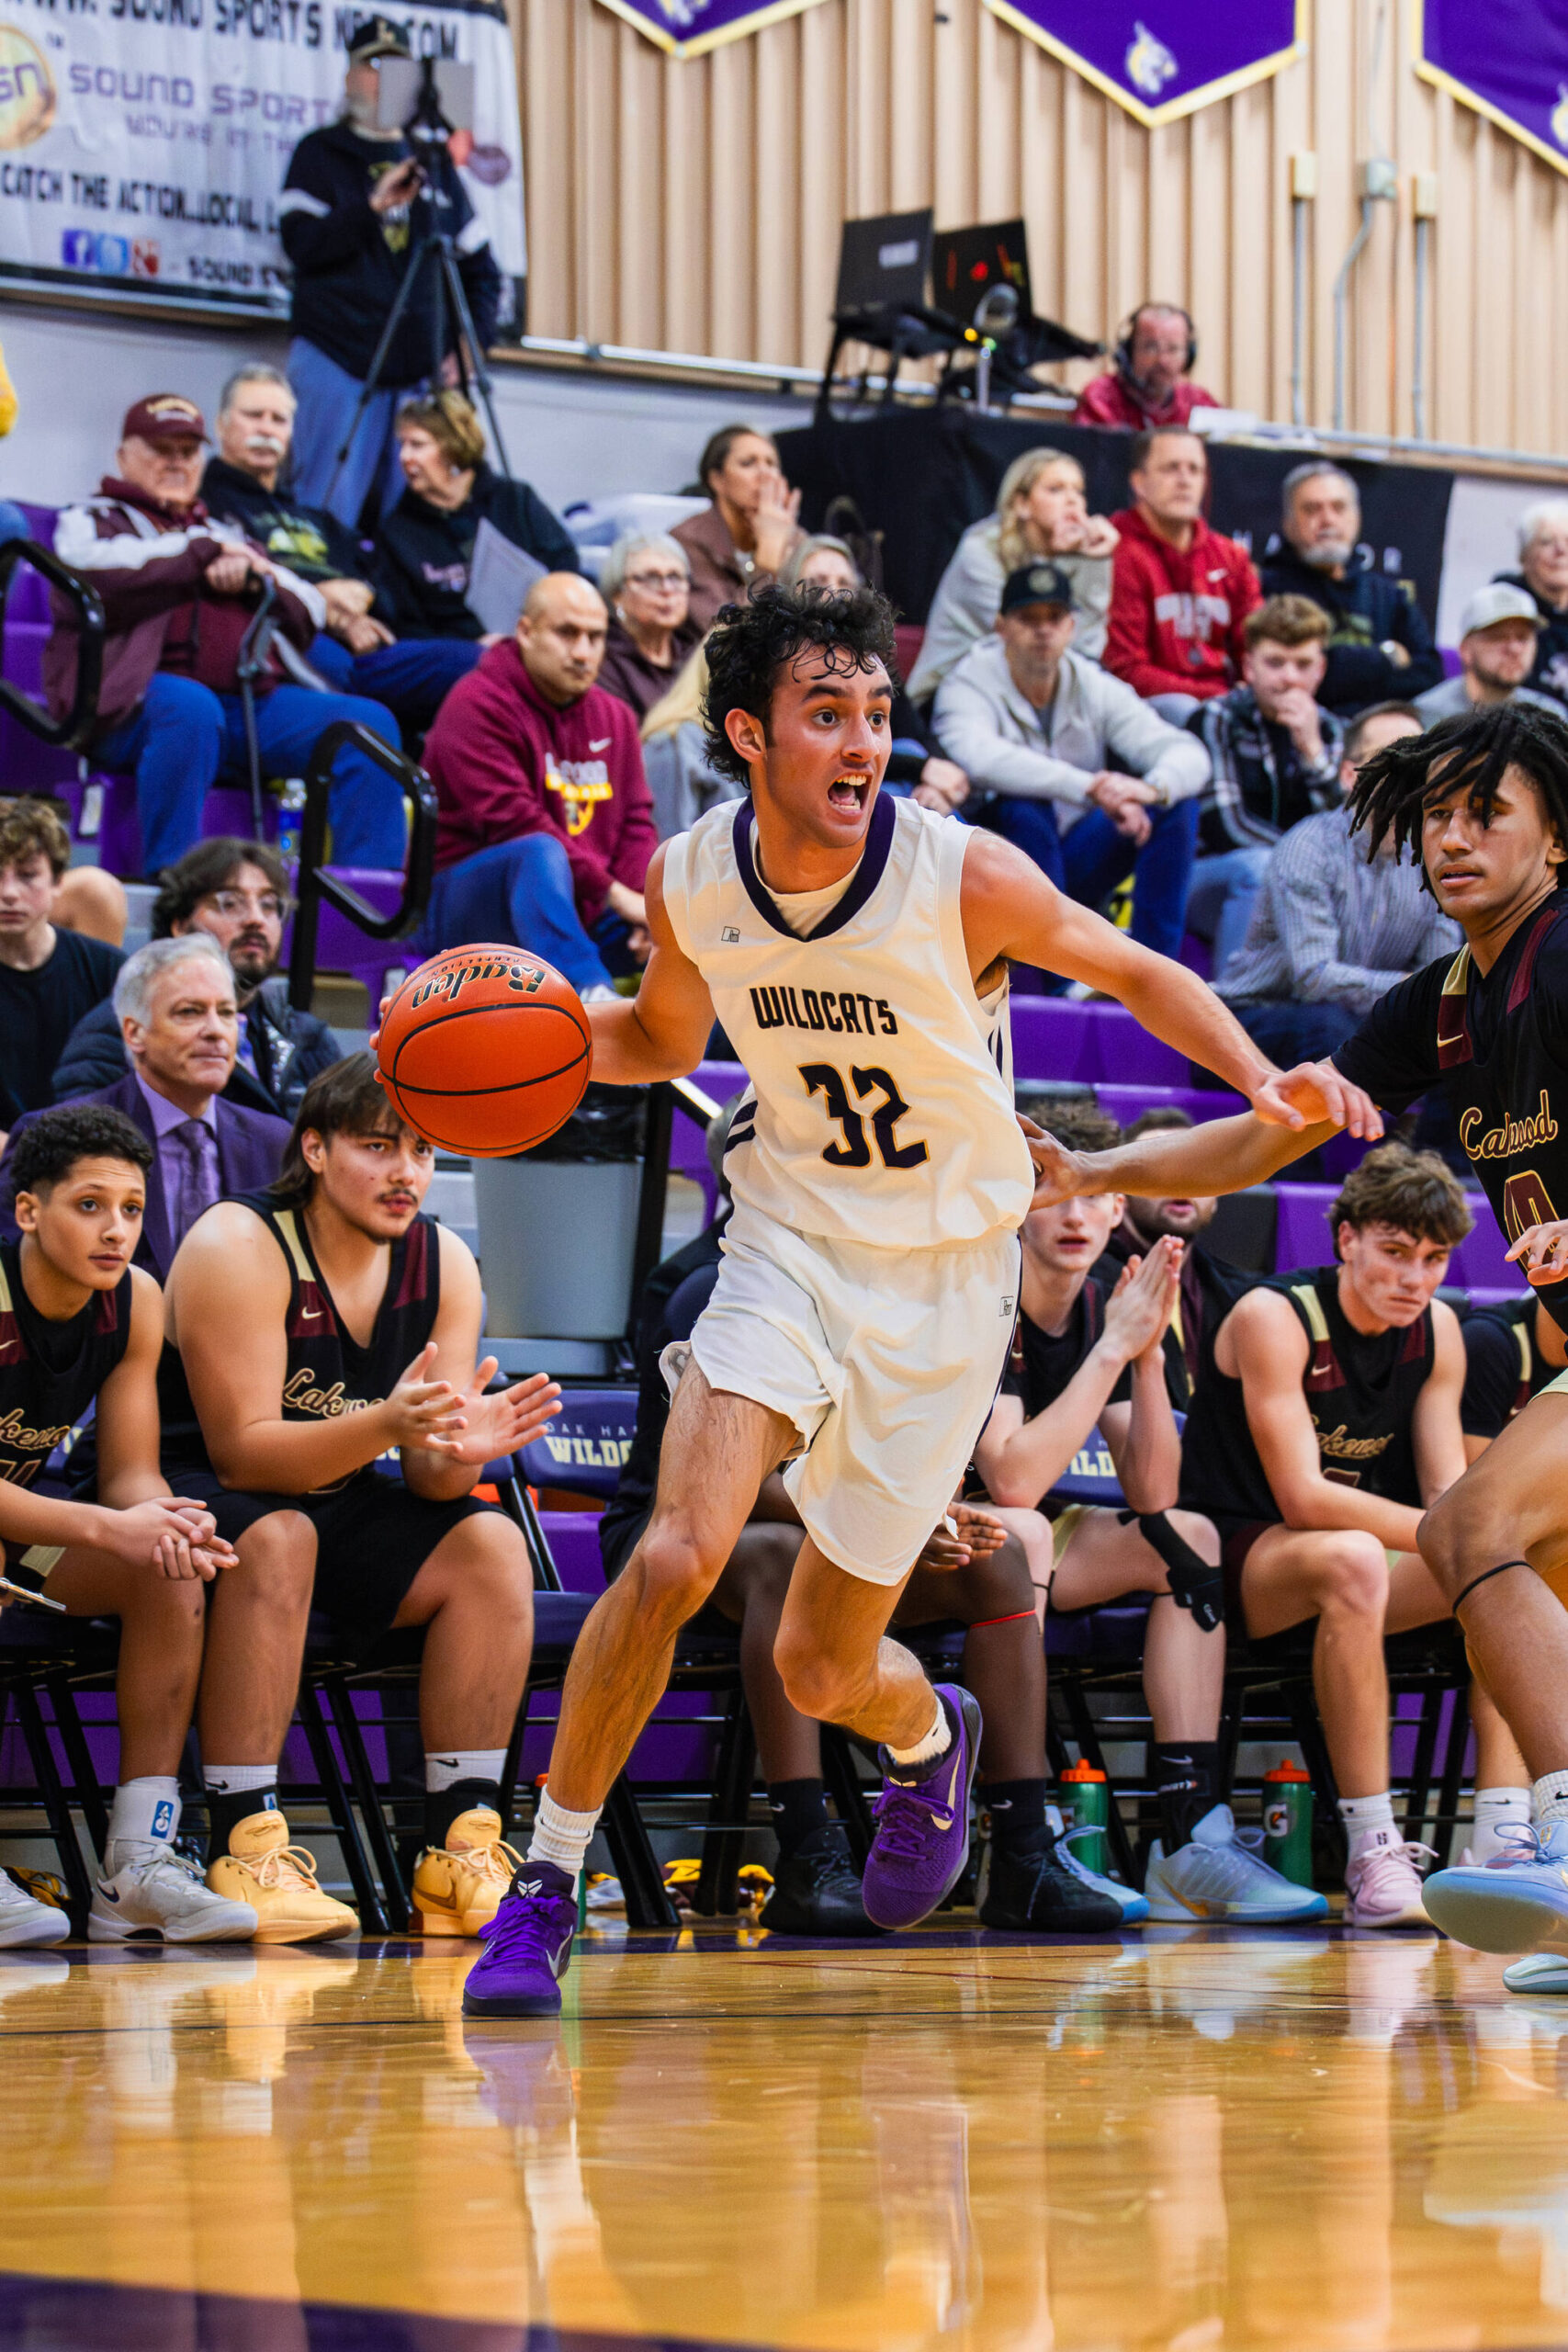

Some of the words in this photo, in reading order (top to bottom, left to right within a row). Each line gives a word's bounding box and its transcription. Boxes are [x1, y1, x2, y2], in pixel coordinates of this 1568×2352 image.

[70, 63, 194, 108] SOUND
[210, 84, 332, 127] SPORT
[2, 163, 62, 201] CATCH
[71, 172, 108, 209] THE
[412, 963, 547, 1011] Baden
[749, 986, 898, 1035] WILDCATS
[795, 1061, 930, 1170] 32
